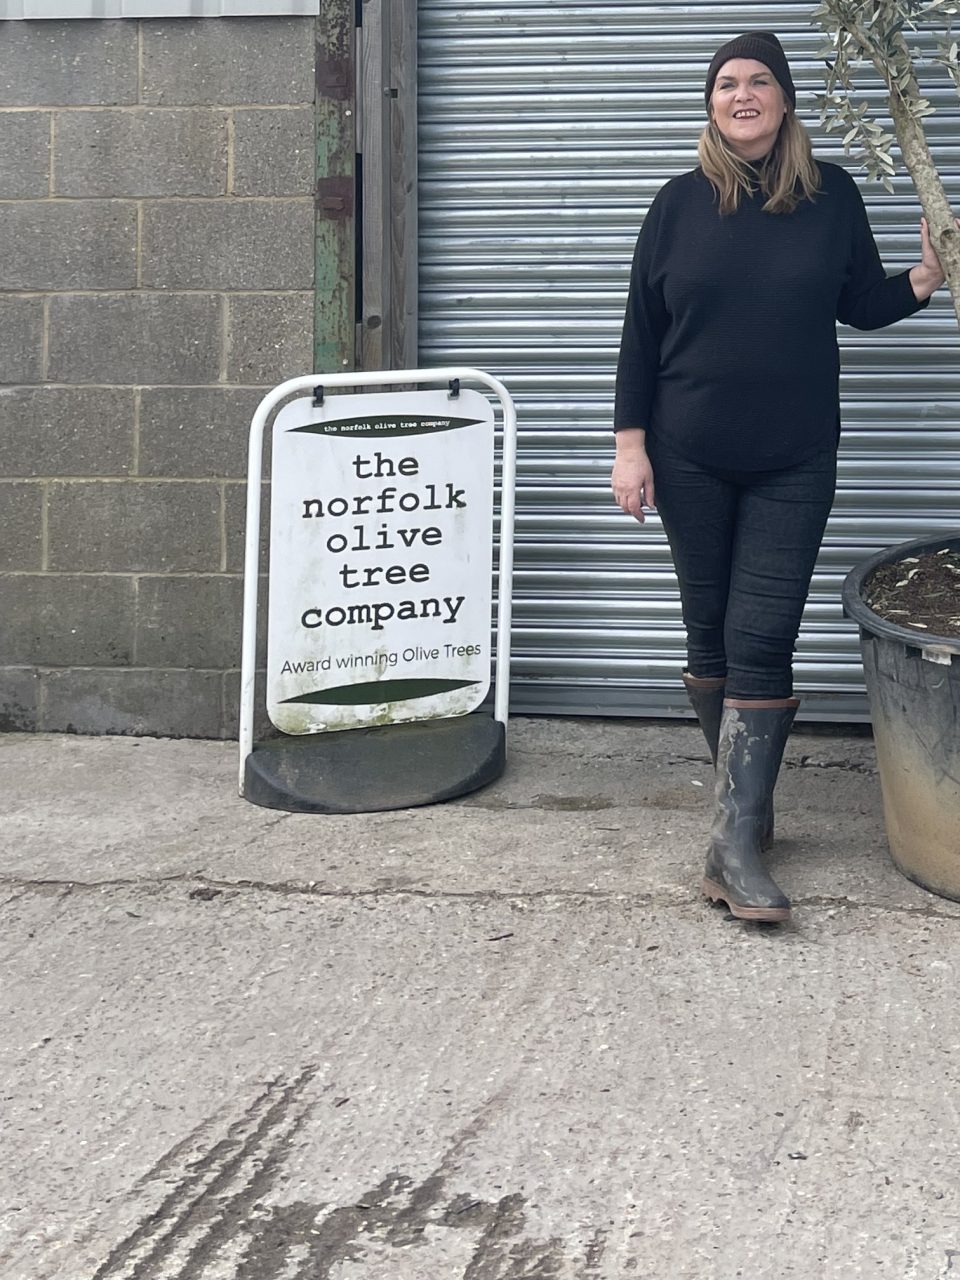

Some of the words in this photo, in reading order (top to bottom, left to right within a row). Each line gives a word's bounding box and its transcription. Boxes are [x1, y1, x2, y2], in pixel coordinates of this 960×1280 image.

[341, 423, 371, 431] norfolk
[375, 422, 396, 430] olive
[352, 452, 419, 479] the
[302, 484, 467, 518] norfolk
[326, 523, 443, 553] olive
[339, 563, 430, 588] tree
[301, 595, 466, 630] company
[280, 658, 332, 675] Award
[335, 651, 398, 669] winning
[402, 647, 440, 662] Olive
[444, 643, 482, 657] Trees
